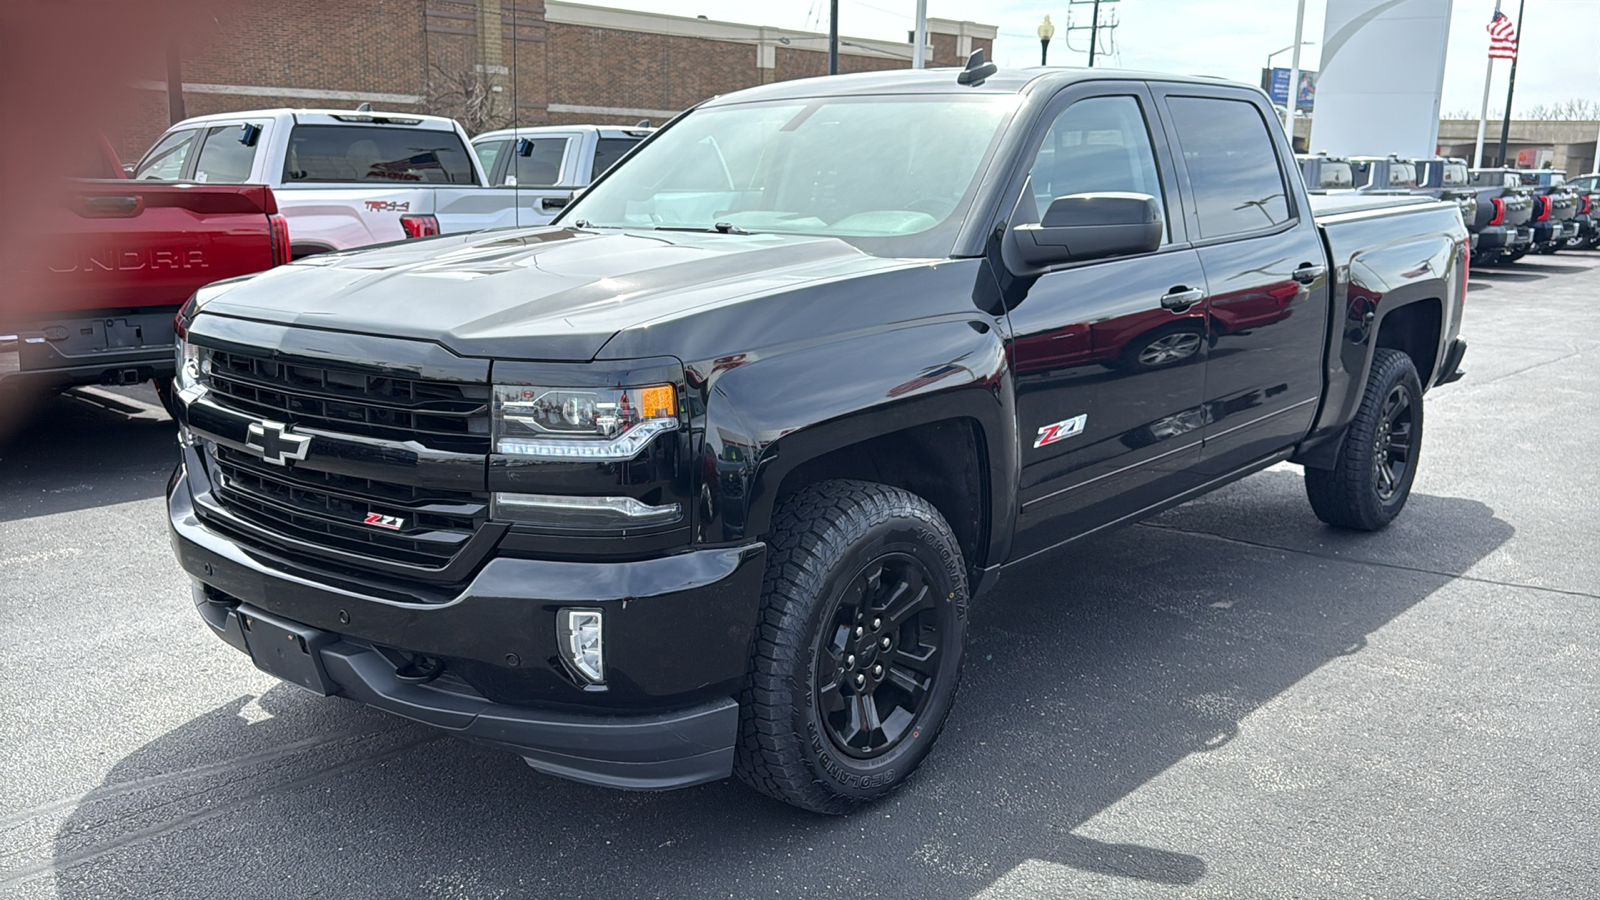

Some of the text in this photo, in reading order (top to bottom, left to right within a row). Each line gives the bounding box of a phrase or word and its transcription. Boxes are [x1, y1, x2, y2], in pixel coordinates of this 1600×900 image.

[22, 246, 209, 273] UNDRA
[1033, 413, 1088, 449] Z71
[364, 511, 404, 530] Z71
[917, 526, 965, 621] YOKOHAMA
